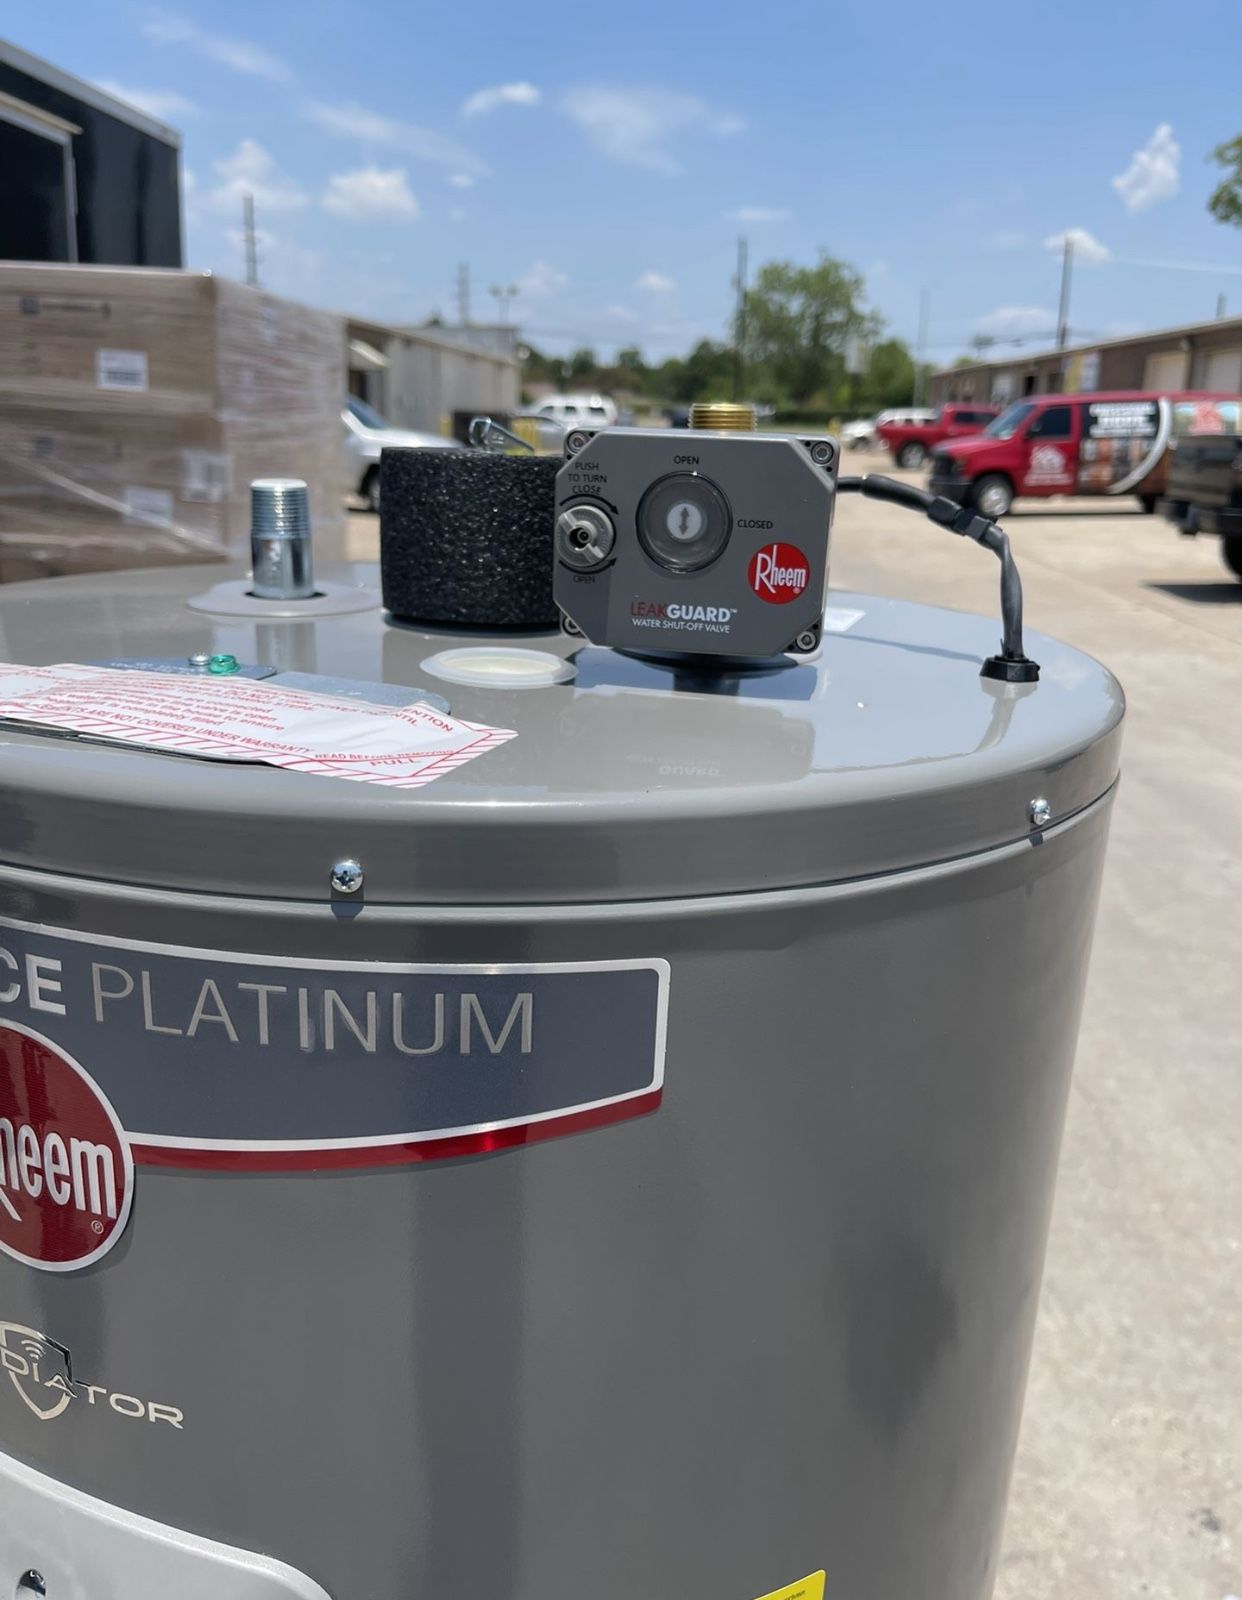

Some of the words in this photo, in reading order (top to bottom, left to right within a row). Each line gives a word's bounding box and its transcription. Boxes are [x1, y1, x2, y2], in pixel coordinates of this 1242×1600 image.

[673, 455, 700, 465] OPEN
[574, 461, 600, 471] PUSH
[568, 473, 581, 482] TO
[583, 474, 608, 483] TURN
[572, 484, 602, 496] CLOSE
[737, 519, 774, 530] CLOSED
[754, 544, 807, 594] Rheem
[573, 575, 596, 585] OPEN
[631, 618, 663, 629] WATER
[663, 620, 705, 632] SHUT-OFF
[704, 623, 731, 634] VALVE
[239, 718, 286, 731] ensure
[195, 728, 241, 741] UNDER
[240, 735, 317, 753] WARRANTY
[315, 752, 347, 760] READ
[91, 962, 535, 1056] PLATINUM
